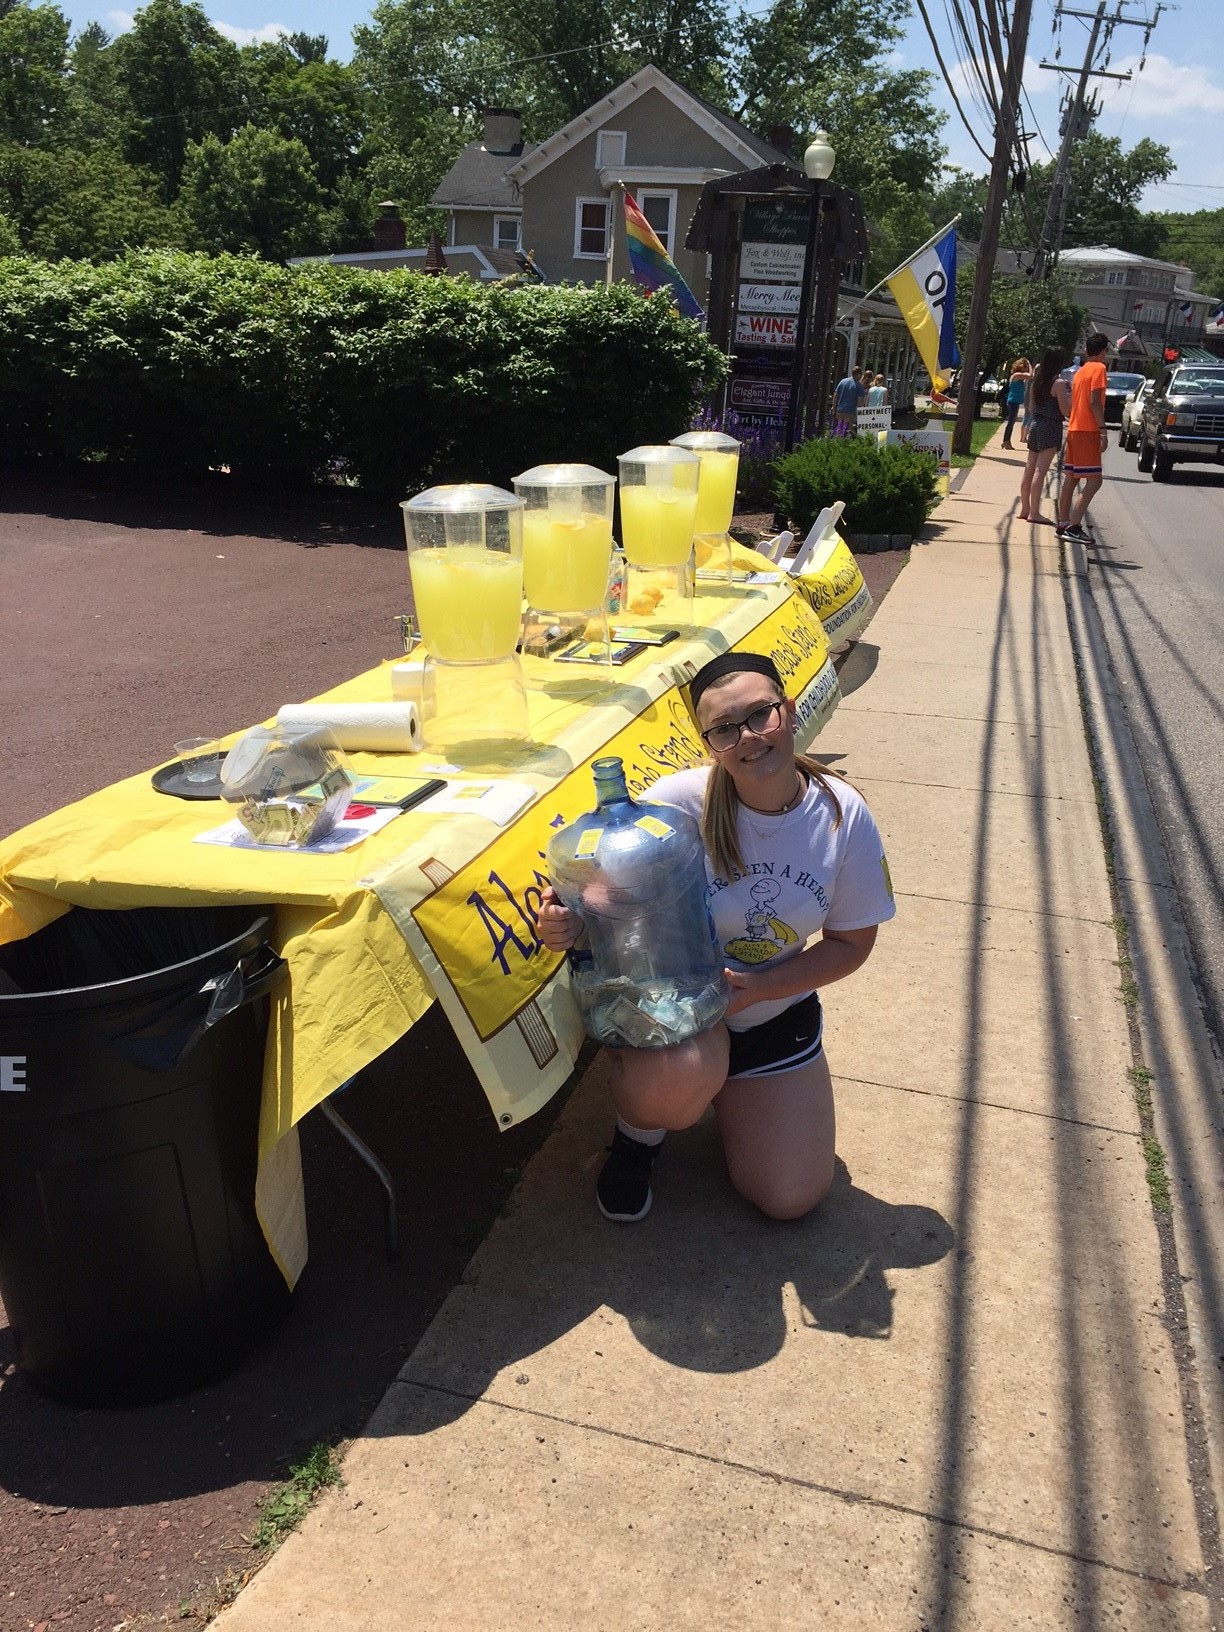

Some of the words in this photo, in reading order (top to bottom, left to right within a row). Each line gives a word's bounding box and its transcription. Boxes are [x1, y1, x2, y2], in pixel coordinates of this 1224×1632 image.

[763, 249, 769, 257] &
[765, 269, 797, 277] Woodworking
[741, 287, 775, 305] Merry
[777, 288, 801, 302] Mee
[749, 316, 795, 335] WINE
[737, 332, 767, 345] Tasting
[770, 334, 777, 343] &
[734, 386, 765, 398] Elegant
[765, 417, 788, 427] Hear
[780, 864, 791, 879] A
[794, 871, 830, 914] HERO?
